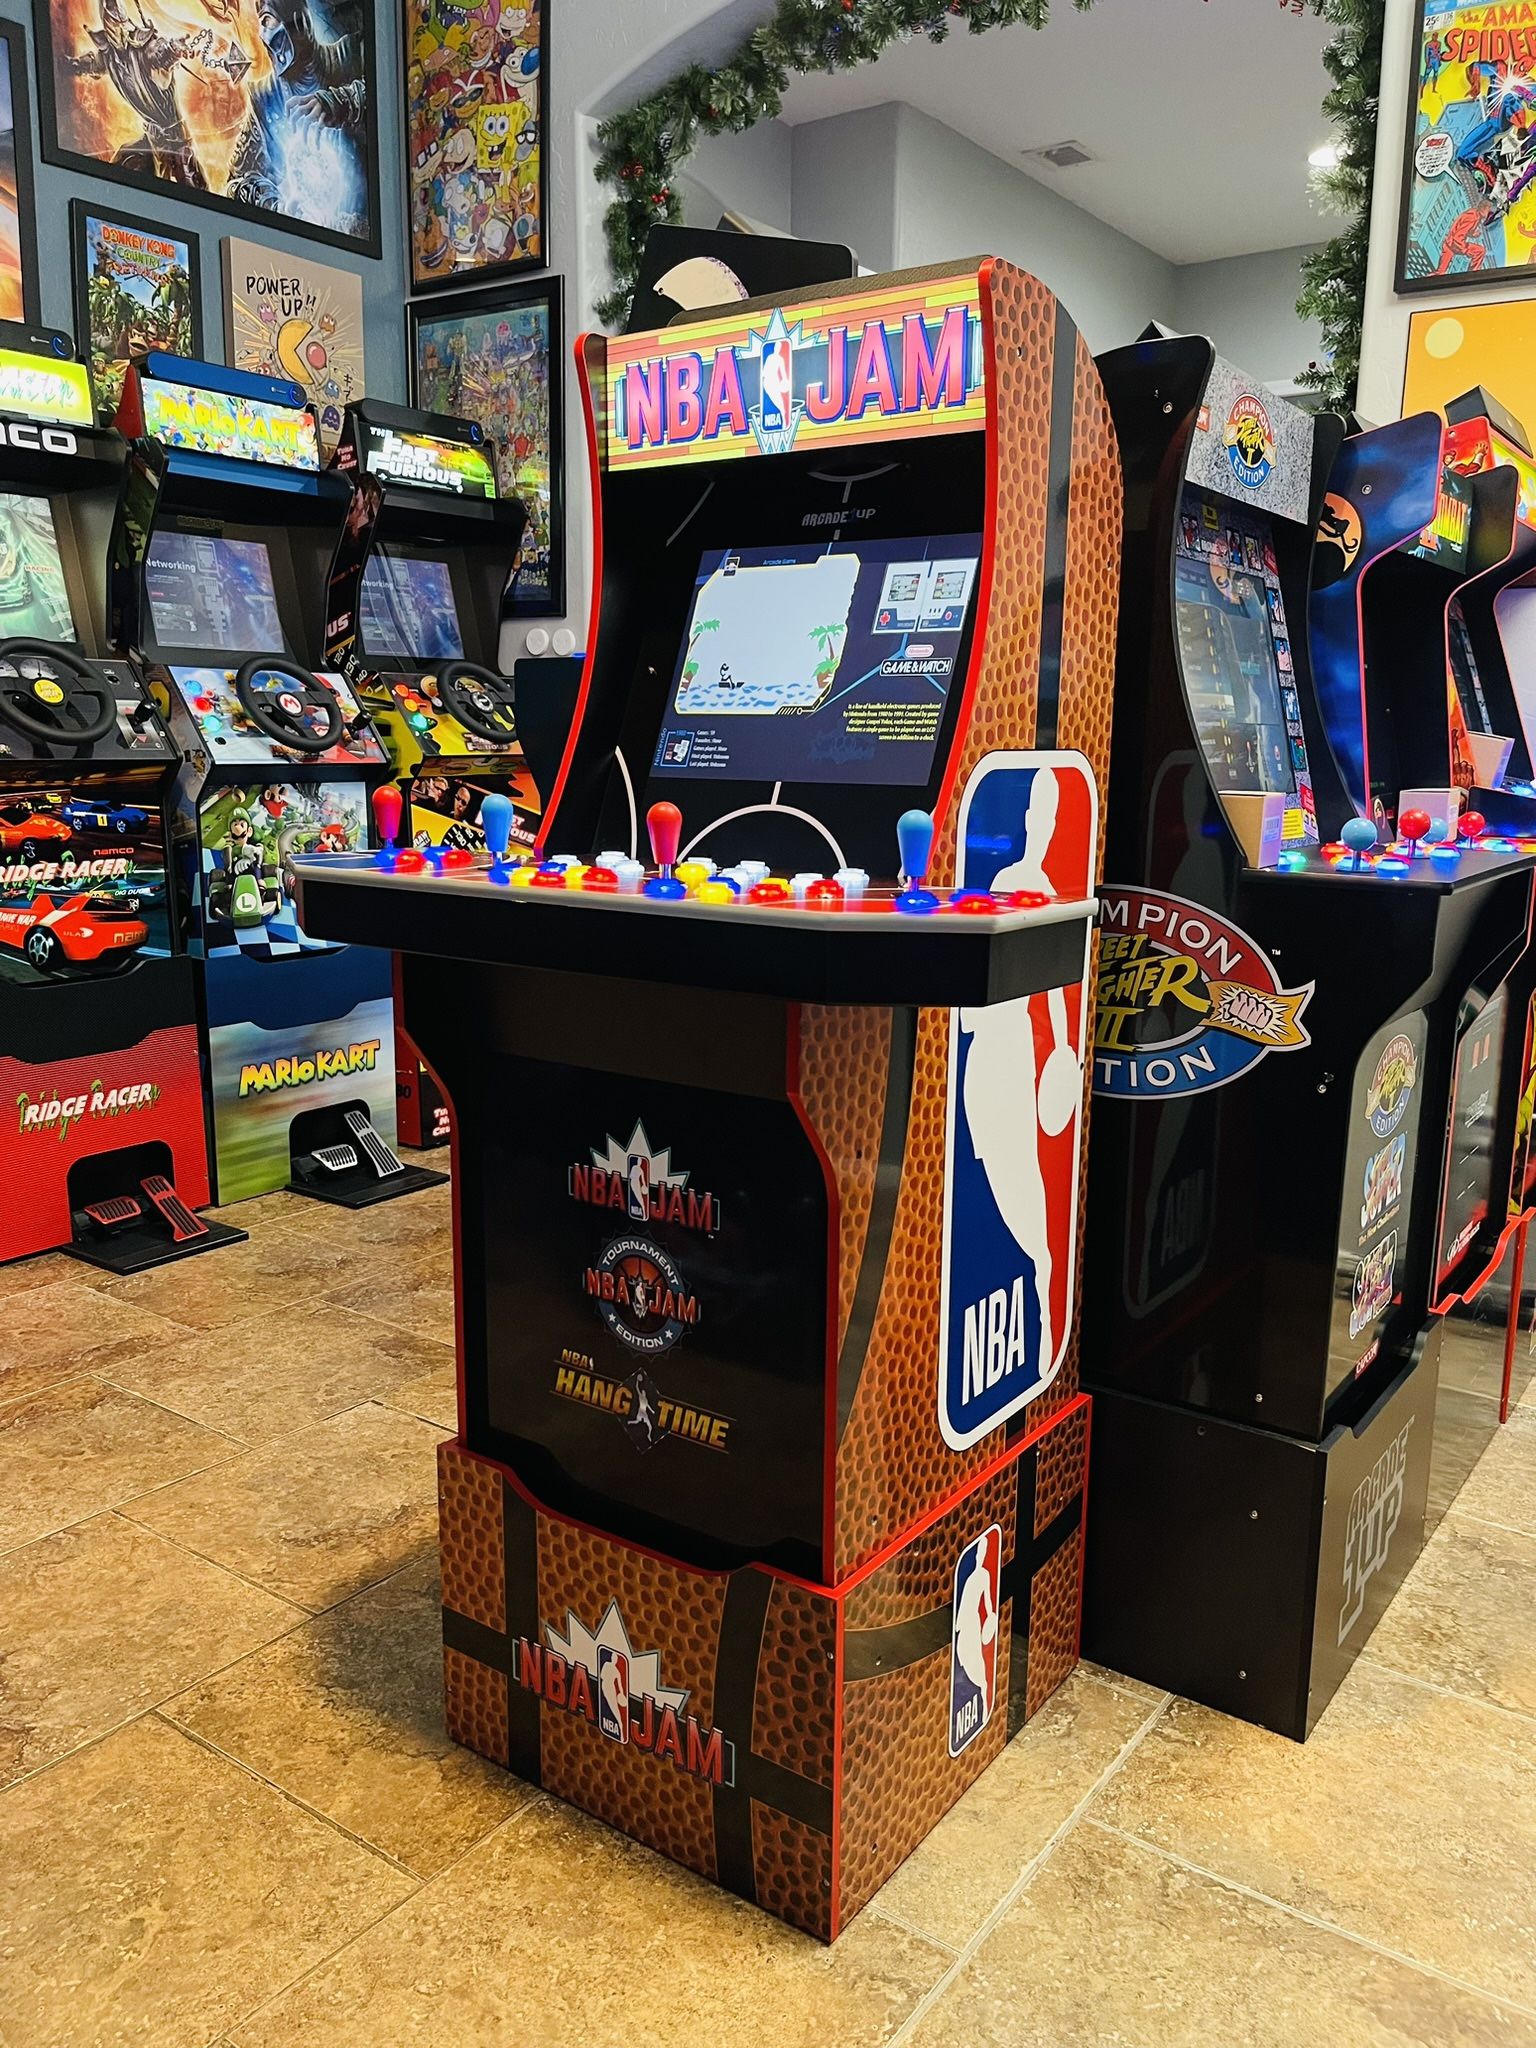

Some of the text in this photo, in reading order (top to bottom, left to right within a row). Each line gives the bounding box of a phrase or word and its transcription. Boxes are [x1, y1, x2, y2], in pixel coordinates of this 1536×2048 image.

[1483, 2, 1536, 27] AMA
[101, 225, 177, 259] DONKEY KONG
[114, 244, 162, 268] COUNTRY
[246, 276, 301, 297] POWER
[624, 305, 969, 451] NBA JAM
[159, 395, 301, 450] MARIO KART
[764, 413, 782, 427] NBA
[1233, 401, 1271, 437] CHAMPION
[382, 431, 440, 464] FAST
[366, 450, 464, 486] FURIOUS
[1233, 456, 1265, 483] EDITION
[146, 558, 196, 573] Networking
[882, 660, 952, 674] GAME&WATCH
[93, 847, 134, 855] namco
[0, 858, 127, 883] RIDGE RACER
[1100, 899, 1243, 976] MPION
[1098, 954, 1212, 1014] GHTER
[238, 1038, 381, 1099] MARIO KART
[1096, 1046, 1216, 1088] TION
[1377, 1040, 1411, 1081] CHAMPION
[23, 1082, 153, 1125] RIDGE RACER
[1375, 1096, 1405, 1132] EDITION
[432, 1126, 450, 1137] CRU
[573, 1163, 713, 1233] NBA JAM
[602, 1240, 679, 1285] TOURNAMENT
[586, 1267, 697, 1325] NBA JAM
[615, 1323, 664, 1348] EDITION
[962, 1275, 1025, 1407] NBA
[561, 1348, 589, 1368] NBA
[555, 1367, 730, 1448] HANG TIME
[518, 1635, 724, 1786] NBA JAM
[602, 1716, 620, 1736] NBA
[955, 1693, 978, 1744] NBA
